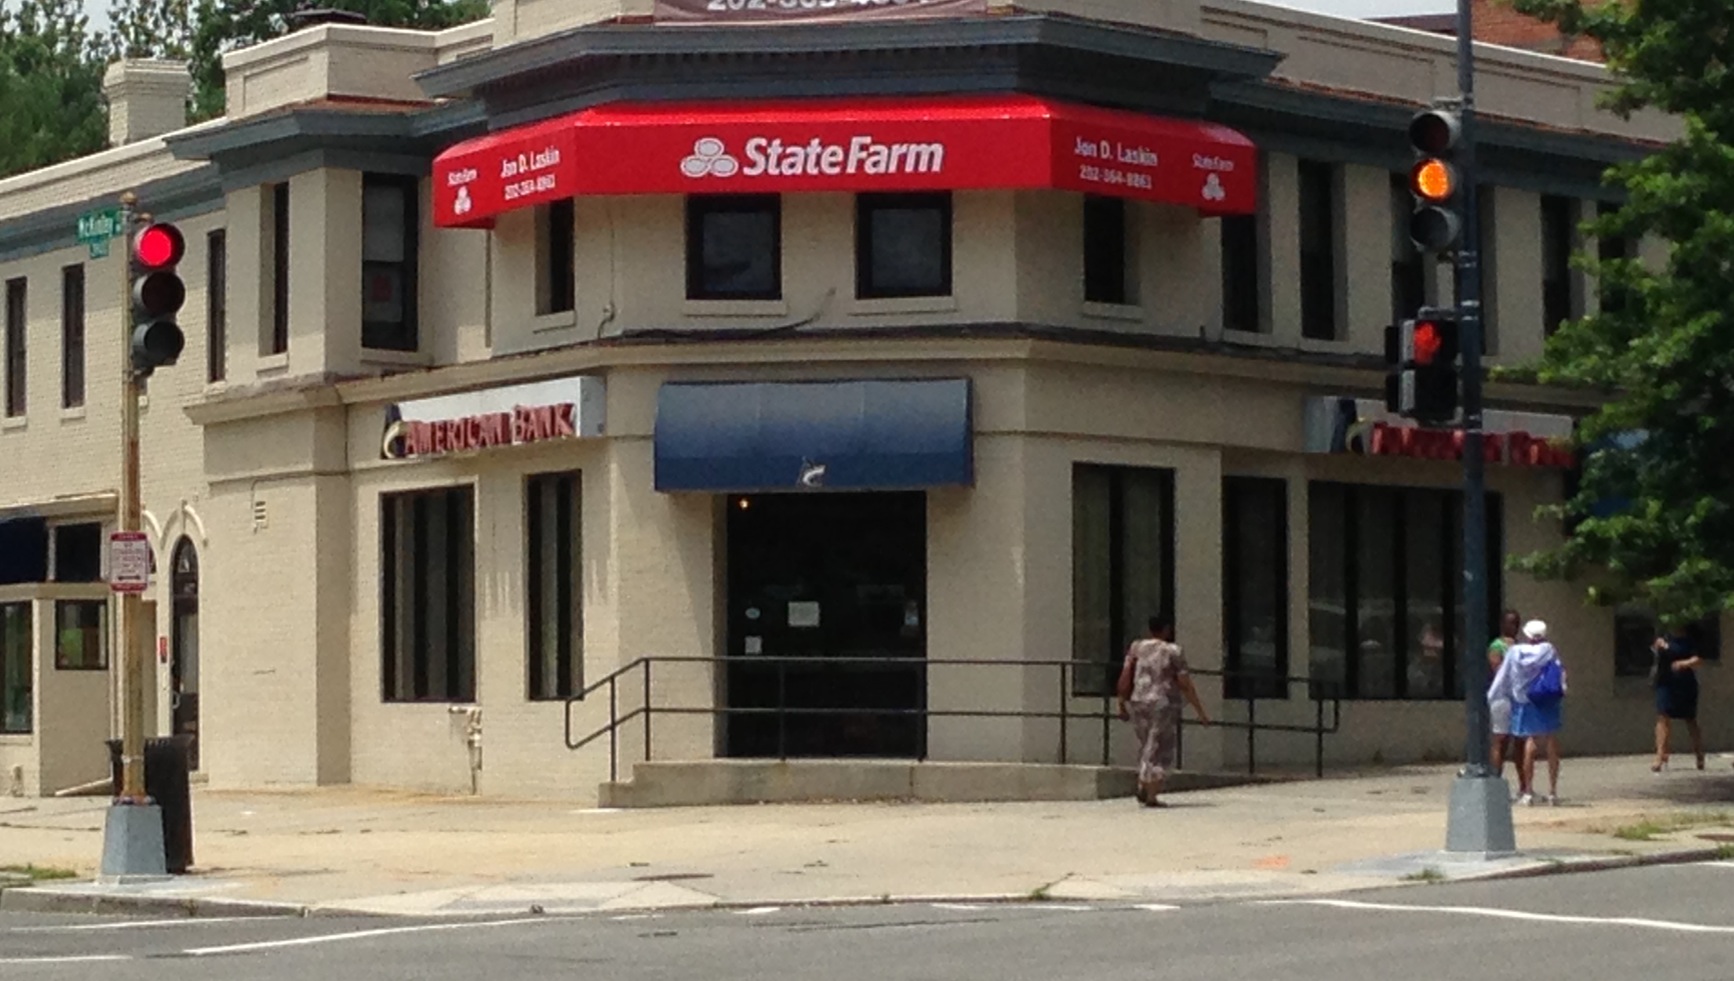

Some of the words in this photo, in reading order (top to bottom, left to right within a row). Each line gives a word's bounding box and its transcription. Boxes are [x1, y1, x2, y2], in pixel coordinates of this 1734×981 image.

[501, 160, 517, 178] Jon
[518, 154, 528, 173] D.
[530, 146, 559, 170] Laskin
[1075, 137, 1097, 157] Jon
[1100, 139, 1114, 160] D.
[1117, 143, 1158, 166] Laskin
[404, 411, 512, 455] AMERICAN
[513, 403, 575, 444] BANK
